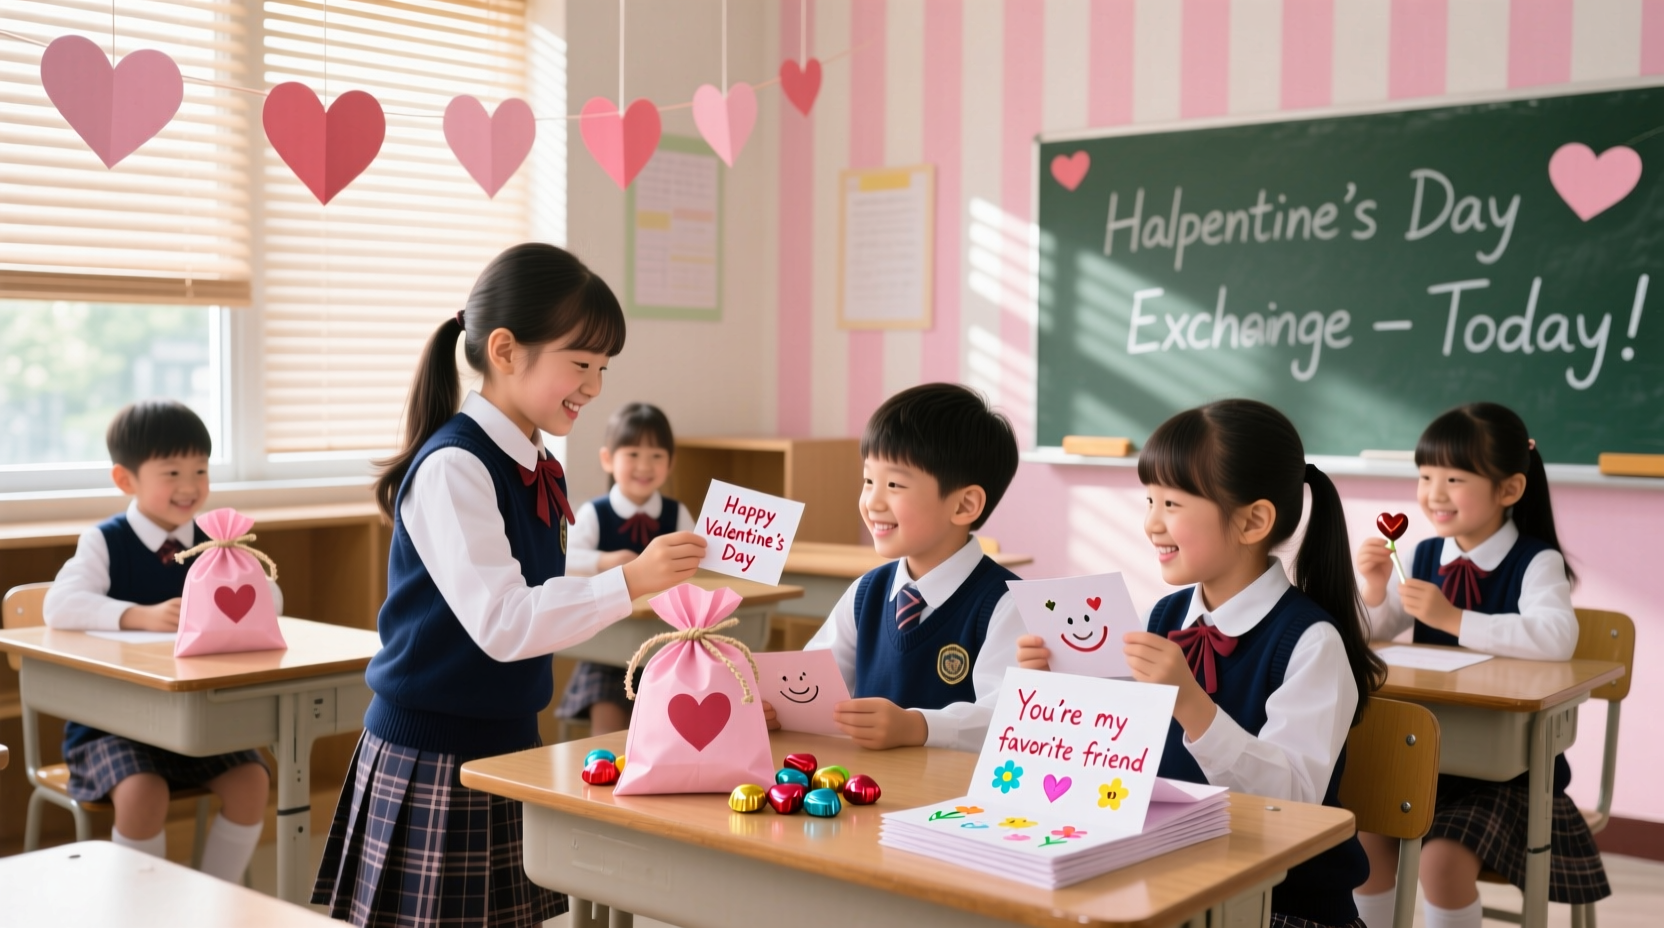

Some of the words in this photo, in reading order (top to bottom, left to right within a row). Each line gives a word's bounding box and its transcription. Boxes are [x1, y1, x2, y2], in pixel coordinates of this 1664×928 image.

[1103, 181, 1378, 272] Halpentine's
[1405, 168, 1521, 264] Day
[1427, 273, 1650, 390] Today!
[706, 517, 784, 551] Valentine's
[723, 495, 776, 529] Happy
[721, 543, 756, 572] Day
[1017, 688, 1082, 725] You're
[1094, 712, 1128, 741] my
[998, 726, 1073, 761] favorite
[1082, 741, 1148, 773] friend
